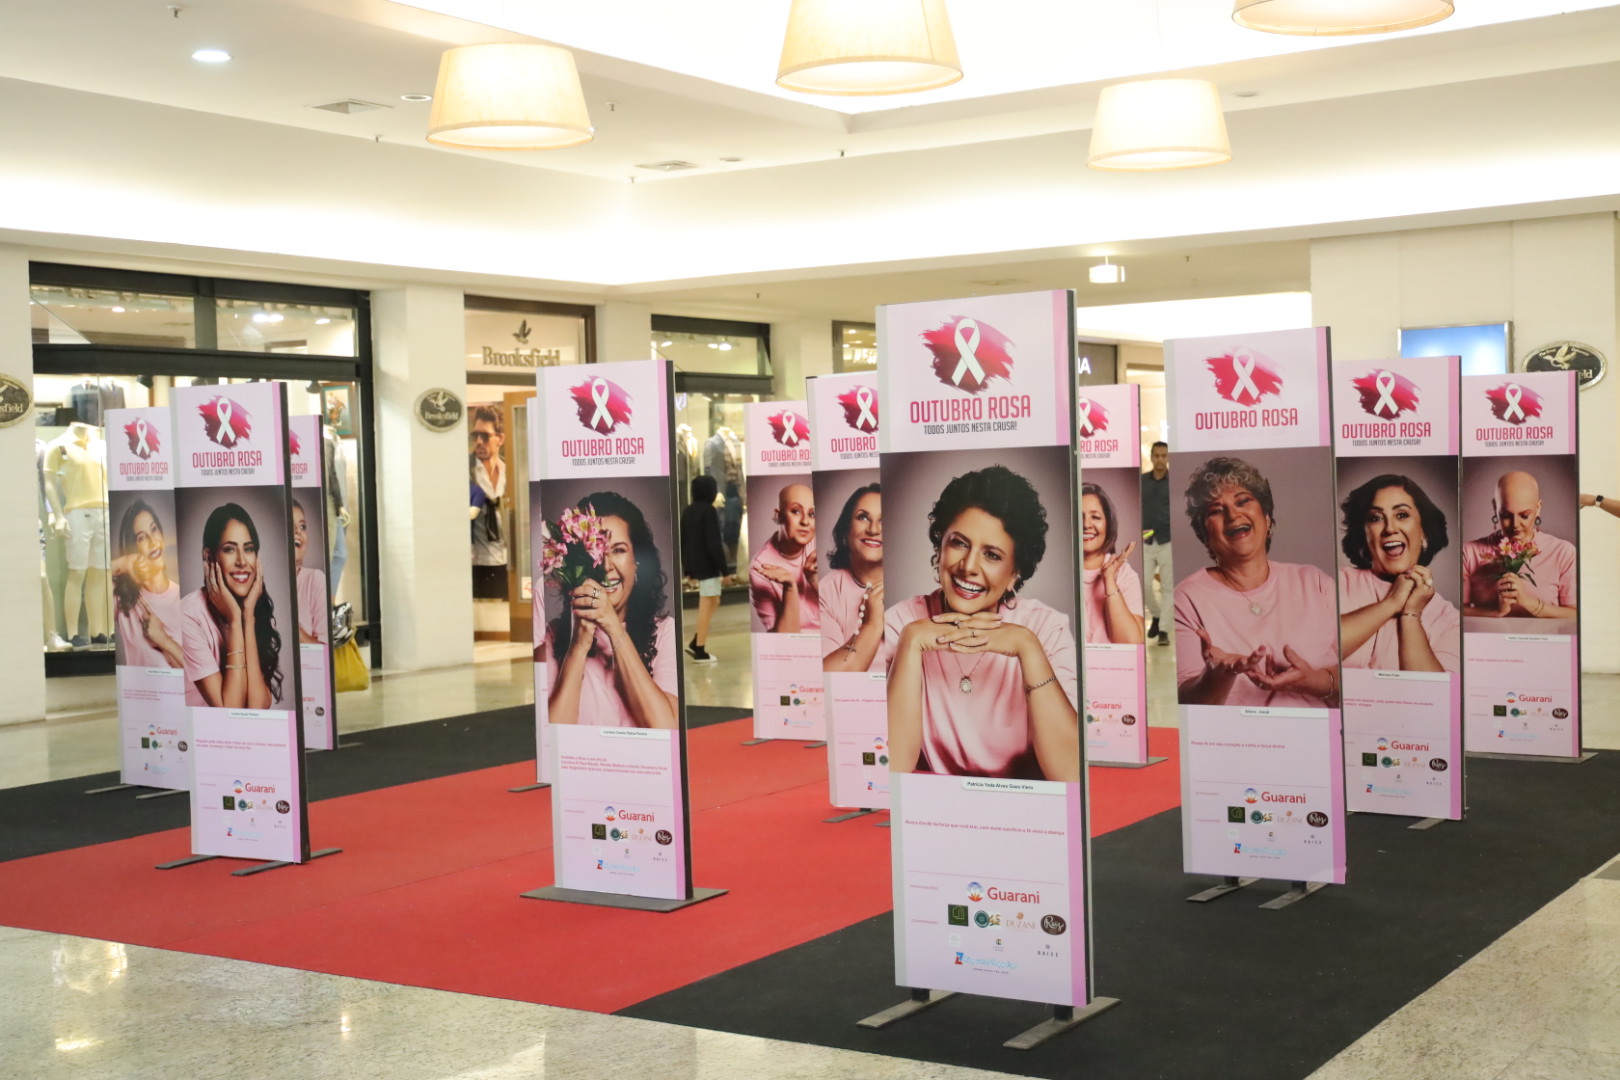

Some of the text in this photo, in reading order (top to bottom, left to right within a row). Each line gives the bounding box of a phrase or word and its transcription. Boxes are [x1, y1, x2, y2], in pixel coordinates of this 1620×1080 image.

[482, 345, 560, 367] Brooksfield
[910, 394, 1031, 424] OUTUBRO ROSA
[1195, 407, 1298, 430] OUTUBRO ROSA
[924, 421, 1017, 435] TODOS JUNTOS NESTA CAUSA!
[1342, 422, 1431, 439] OUTUBRO ROSA
[1476, 426, 1553, 441] OUTUBRO ROSA
[562, 437, 645, 457] OUTUBRO ROSA
[831, 436, 876, 453] OUTUBRO
[1094, 439, 1119, 452] ROSA
[192, 450, 262, 468] OUTUBRO ROSA
[761, 449, 797, 462] OUTUBRO
[119, 461, 168, 475] OUTUBRO ROSA
[291, 463, 308, 474] ROSA
[1092, 701, 1122, 709] Guarani
[1518, 693, 1553, 703] Guarani
[157, 726, 178, 735] Guarani
[1391, 740, 1430, 752] Guarani
[245, 782, 276, 794] Guarani
[1261, 791, 1306, 804] Guarani
[618, 809, 655, 822] Guarani
[987, 886, 1040, 905] Guarani
